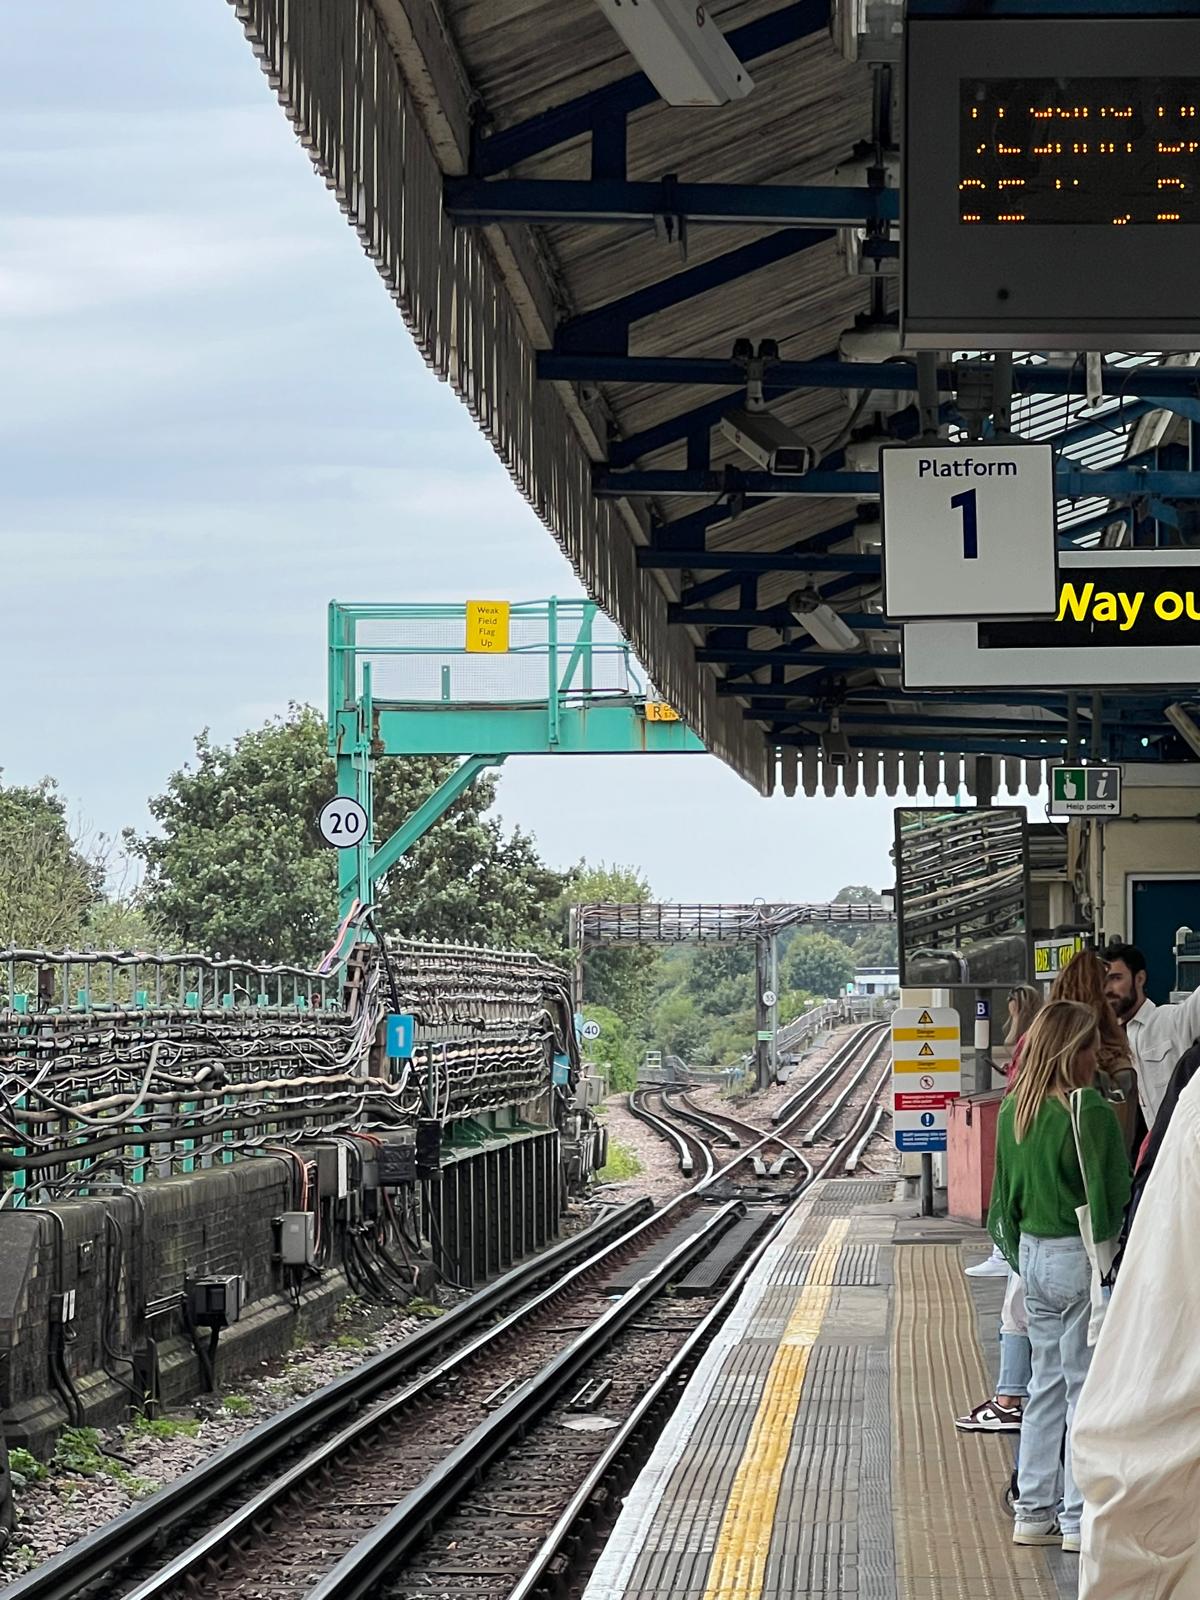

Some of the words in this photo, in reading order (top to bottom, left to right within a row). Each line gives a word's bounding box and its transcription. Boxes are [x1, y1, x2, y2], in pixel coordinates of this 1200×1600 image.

[919, 458, 1017, 477] Platform
[950, 487, 978, 559] 1
[477, 606, 499, 615] Weak
[1055, 582, 1145, 631] Way
[478, 617, 498, 625] Field
[479, 628, 496, 637] Flag
[480, 639, 493, 648] Up
[1066, 803, 1085, 811] Help
[1087, 803, 1107, 811] point
[329, 812, 359, 834] 20
[977, 1002, 986, 1015] B
[584, 1025, 598, 1035] 40
[395, 1026, 405, 1048] 1
